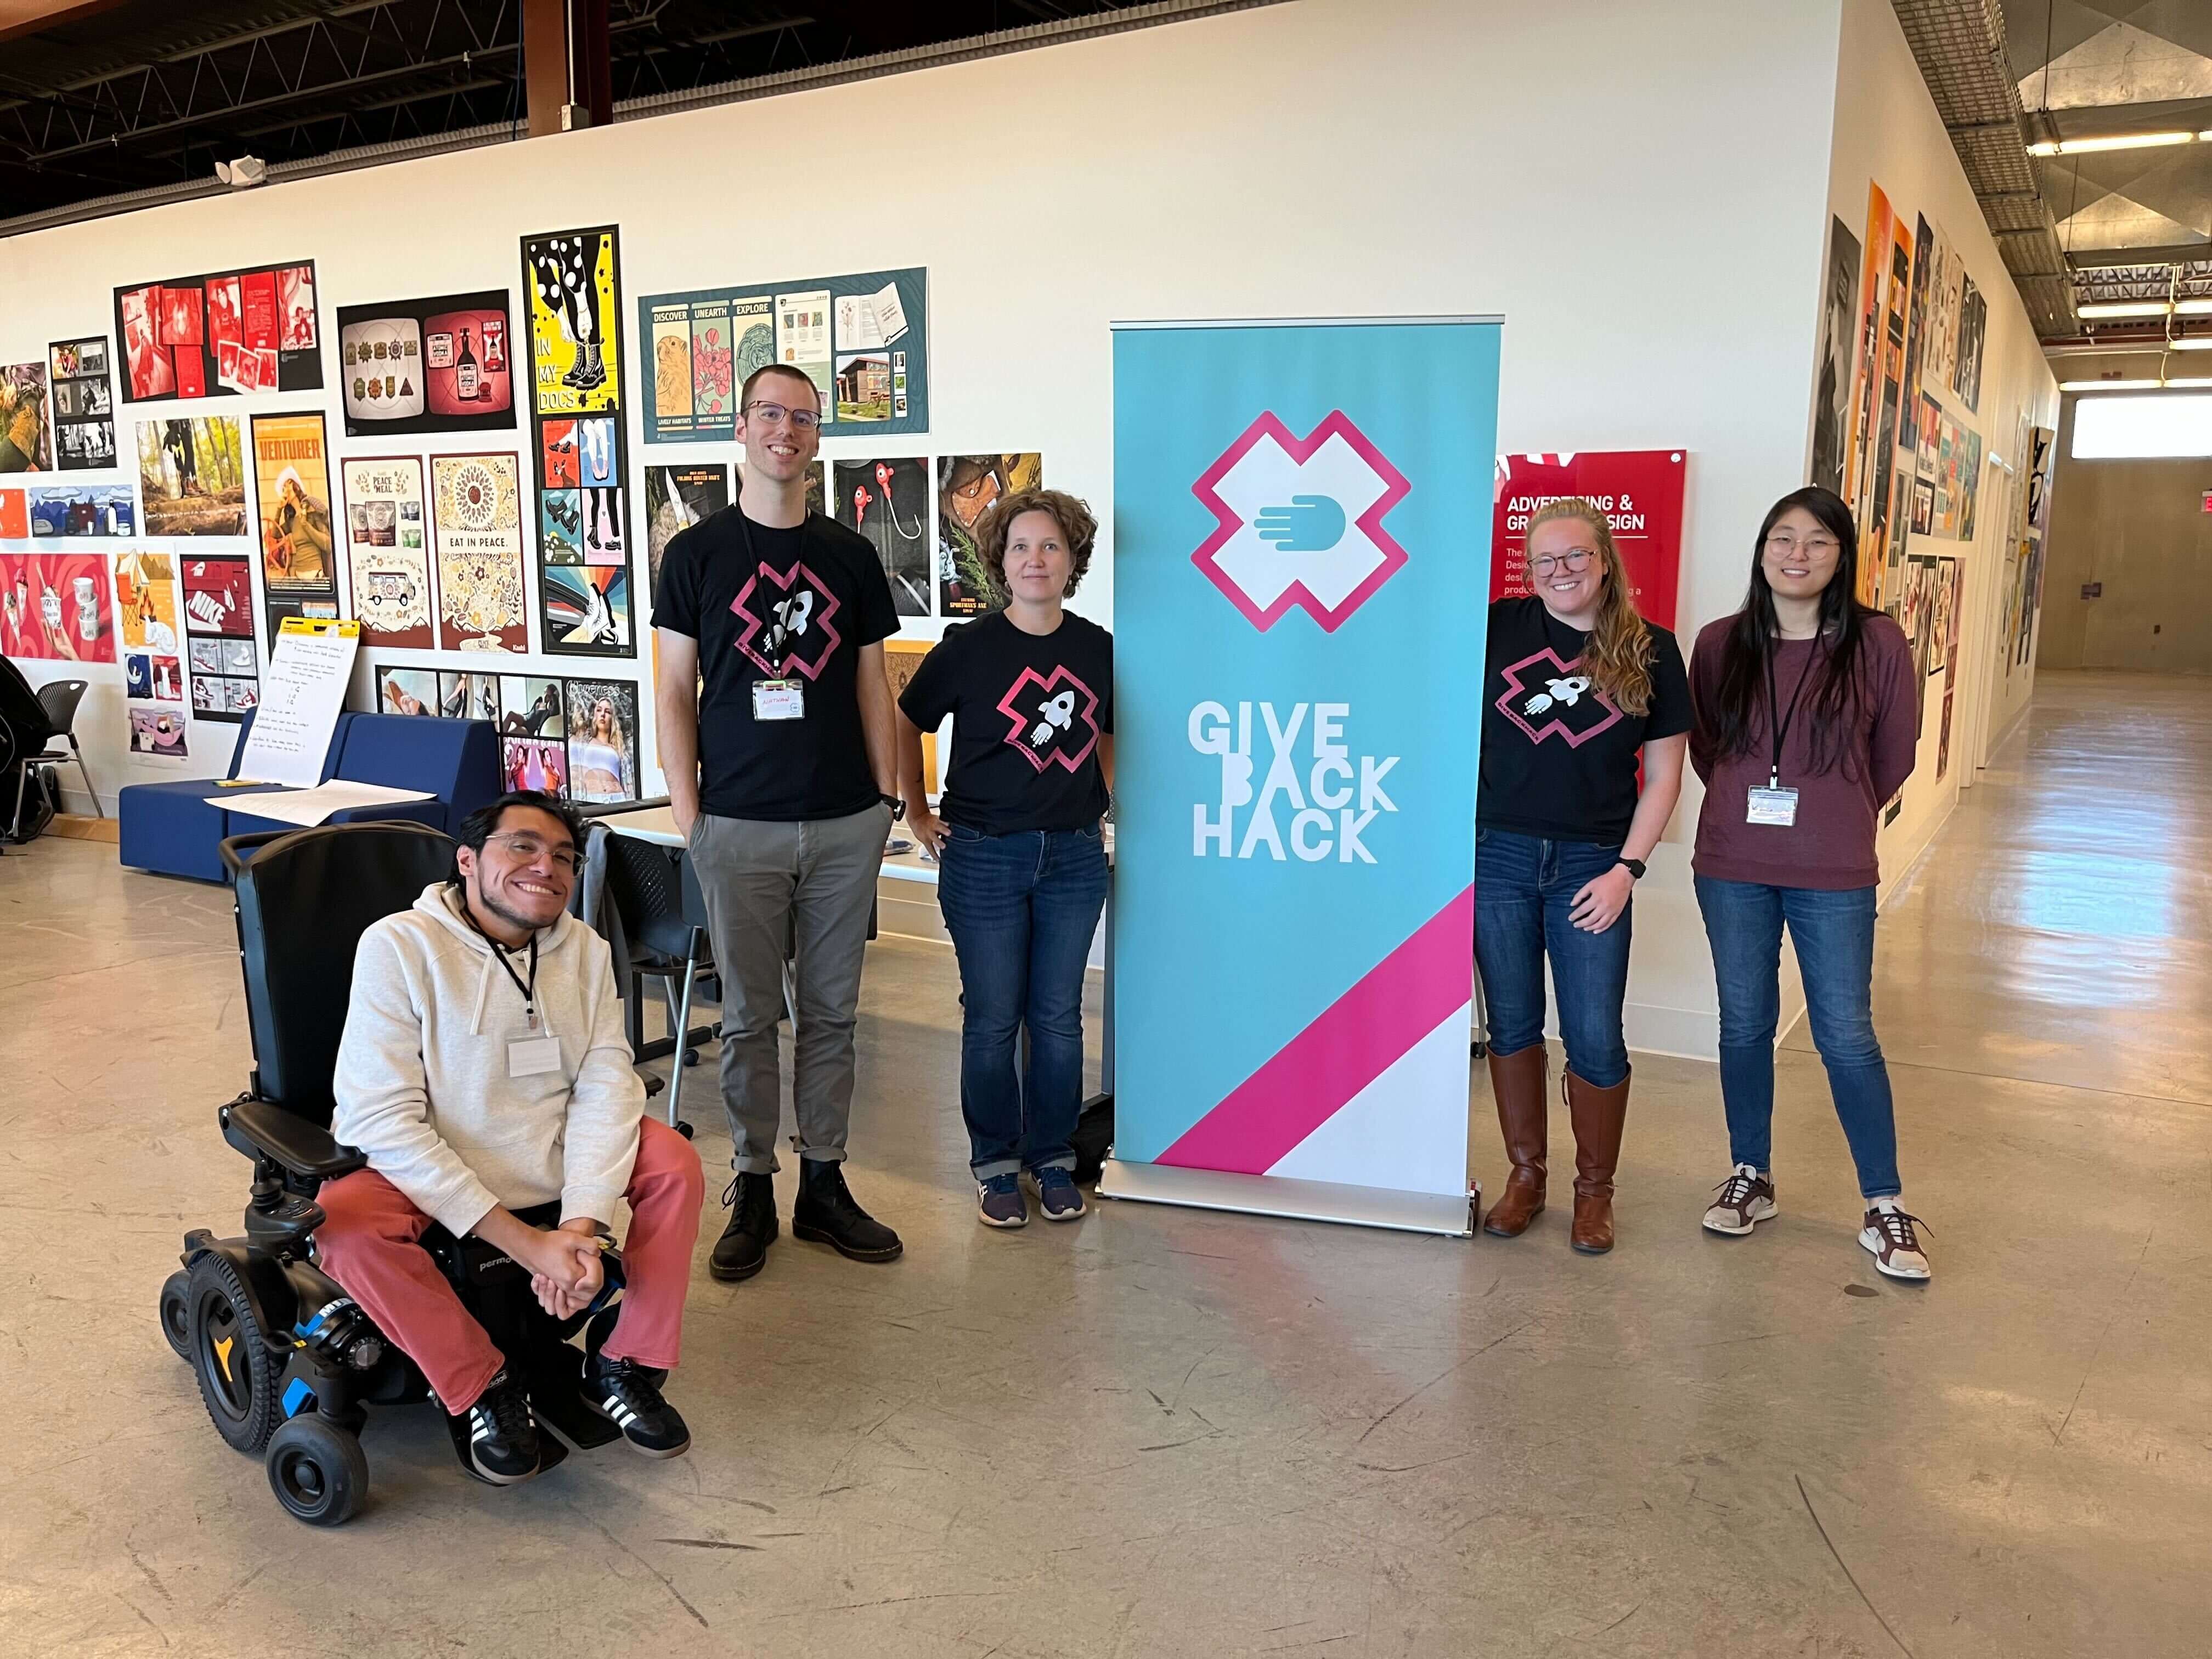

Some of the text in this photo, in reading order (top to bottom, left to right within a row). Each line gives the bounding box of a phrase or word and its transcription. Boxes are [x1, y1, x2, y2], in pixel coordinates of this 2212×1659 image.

[654, 311, 687, 322] DISCOVER
[695, 307, 727, 318] UNEARTH
[737, 303, 768, 314] EXPLORE
[537, 338, 551, 356] IN
[538, 364, 556, 383] MY
[539, 391, 574, 410] DOCS
[260, 439, 320, 461] VENTURER
[374, 485, 392, 493] MEAL
[1507, 494, 1633, 512] ADVEING &
[1606, 514, 1645, 530] SIGN
[450, 538, 508, 547] EAT IN PEACE.
[1506, 548, 1522, 557] The
[189, 590, 225, 624] NIKE
[738, 642, 774, 676] GIVEBACKHA
[1188, 701, 1349, 758] GIVE
[1222, 752, 1401, 812] BACK
[1193, 803, 1380, 864] HACK
[479, 1257, 512, 1272] permo
